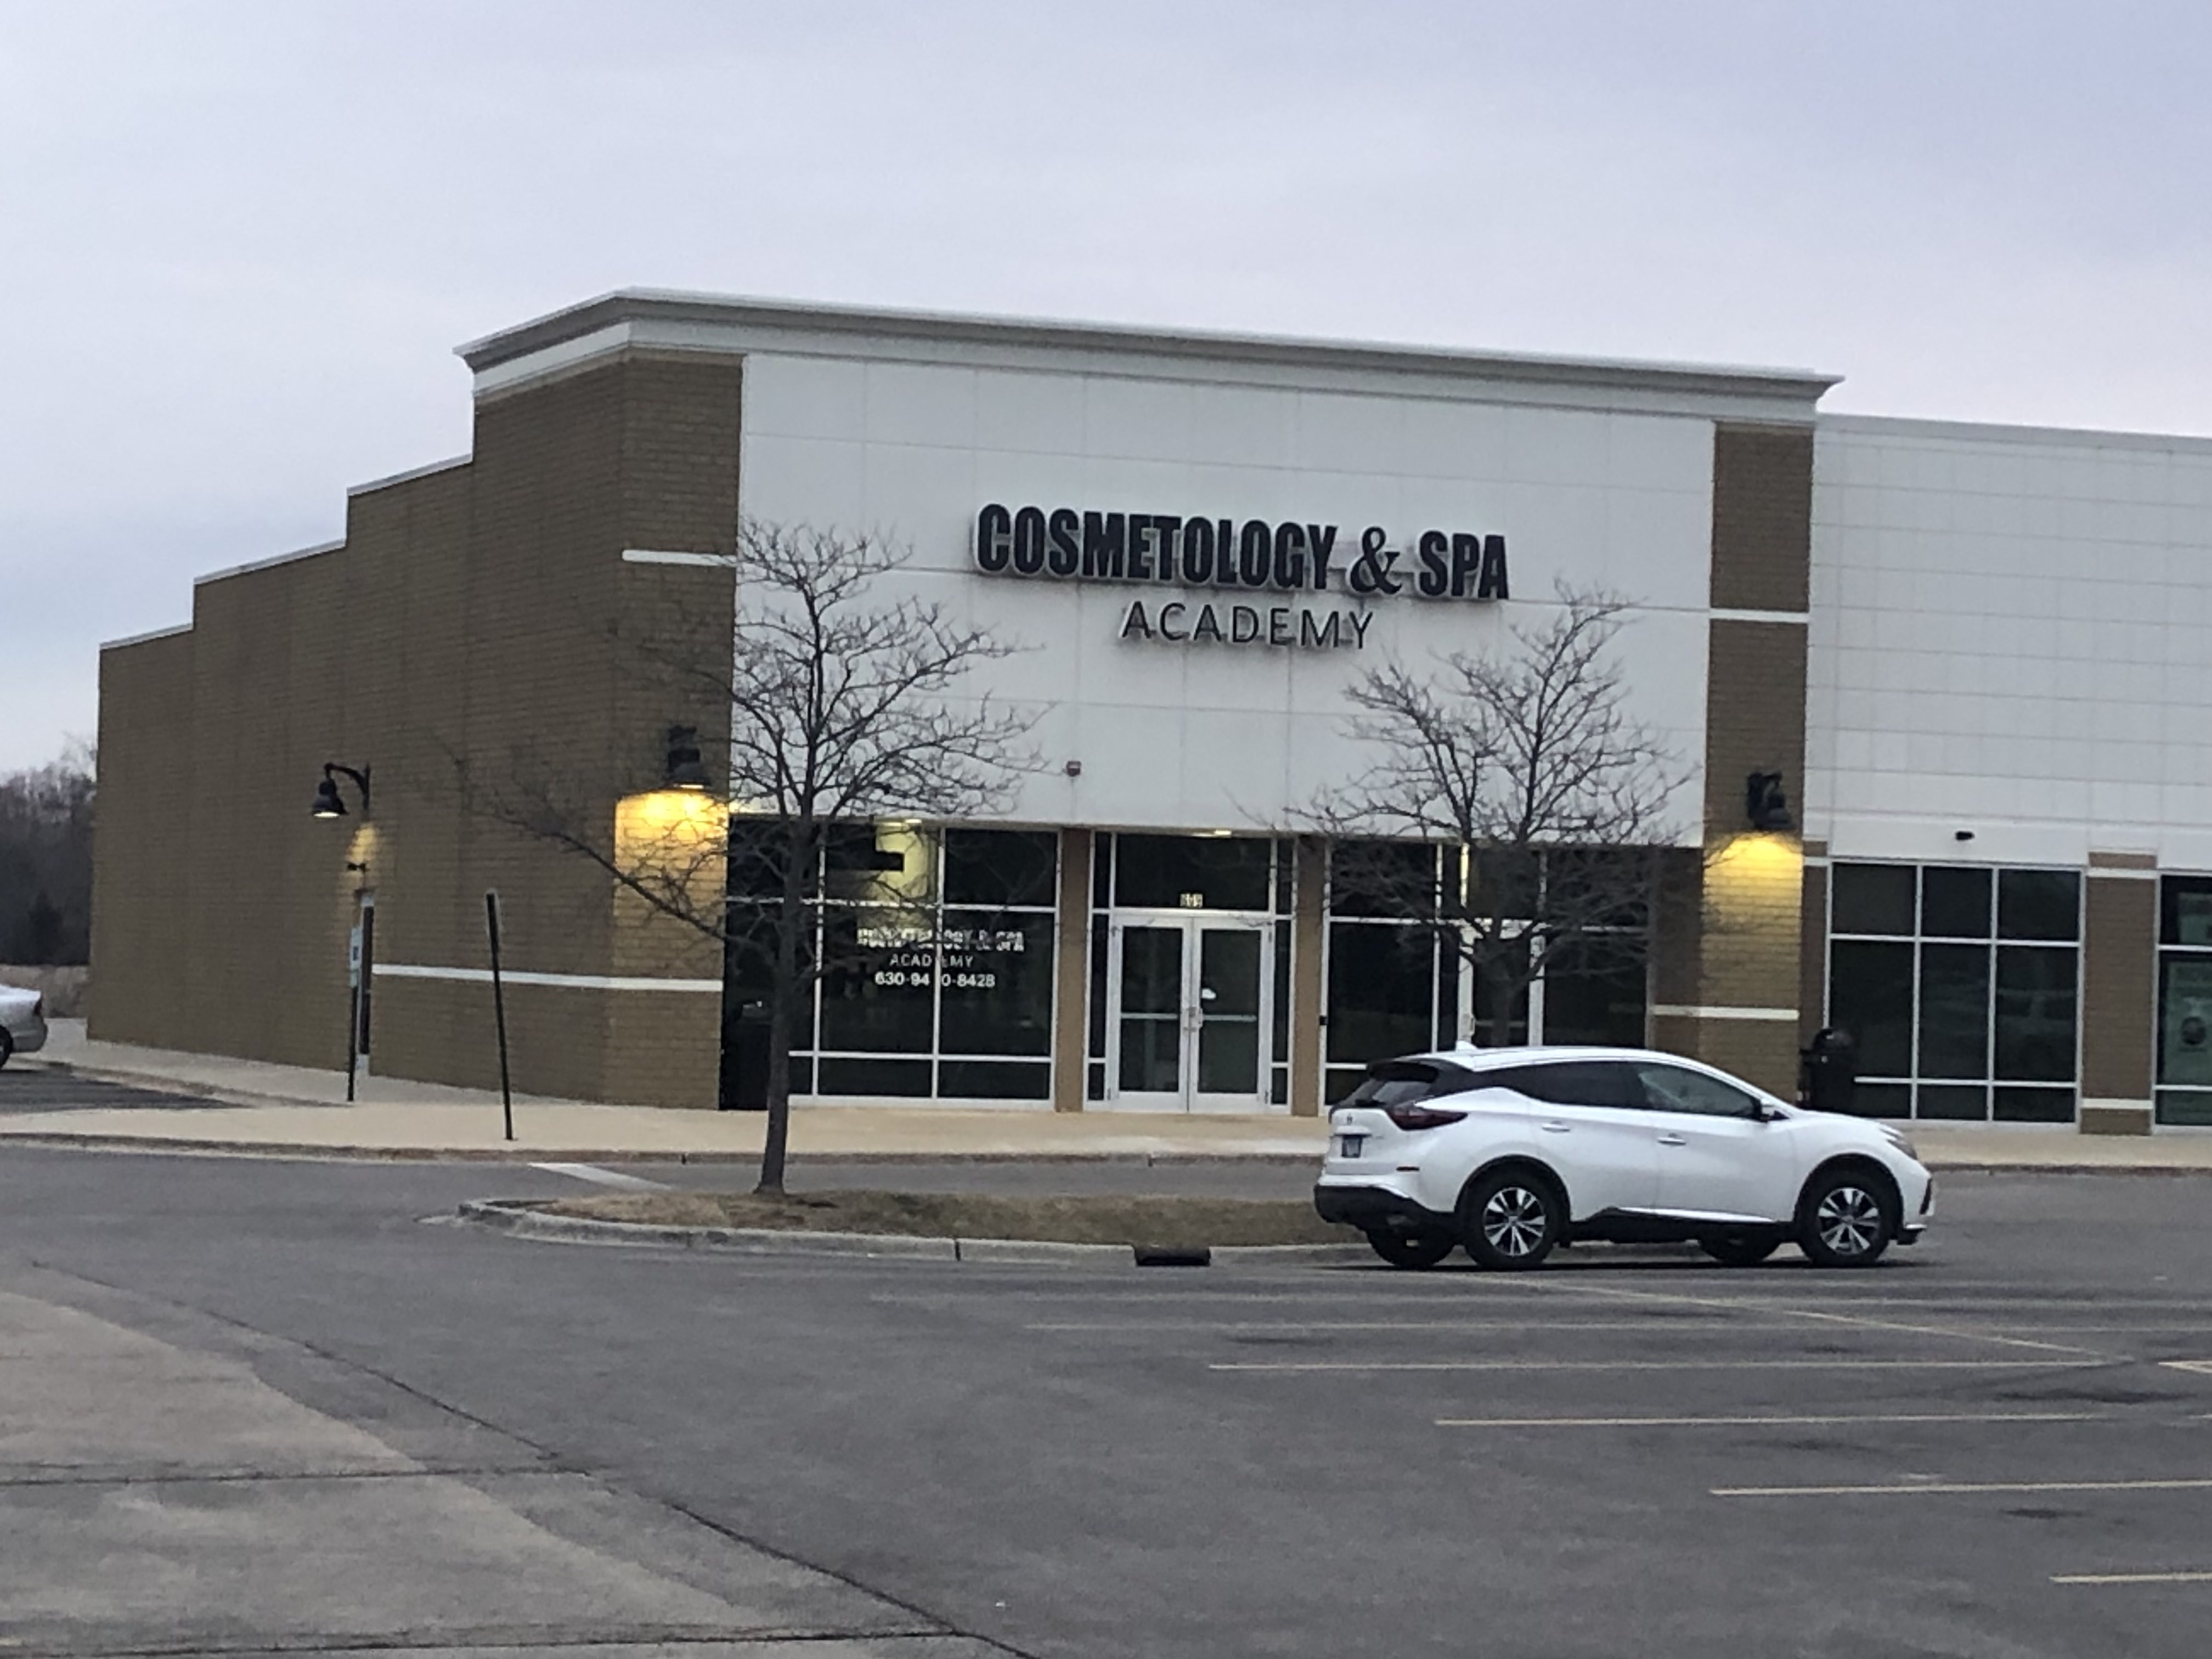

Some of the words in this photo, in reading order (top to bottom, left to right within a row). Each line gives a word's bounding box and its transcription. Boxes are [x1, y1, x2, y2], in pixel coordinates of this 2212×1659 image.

[977, 503, 1338, 590] COSMETOLOGY
[1350, 526, 1402, 595] &
[1419, 530, 1509, 600] SPA
[1121, 601, 1373, 649] ACADEMY
